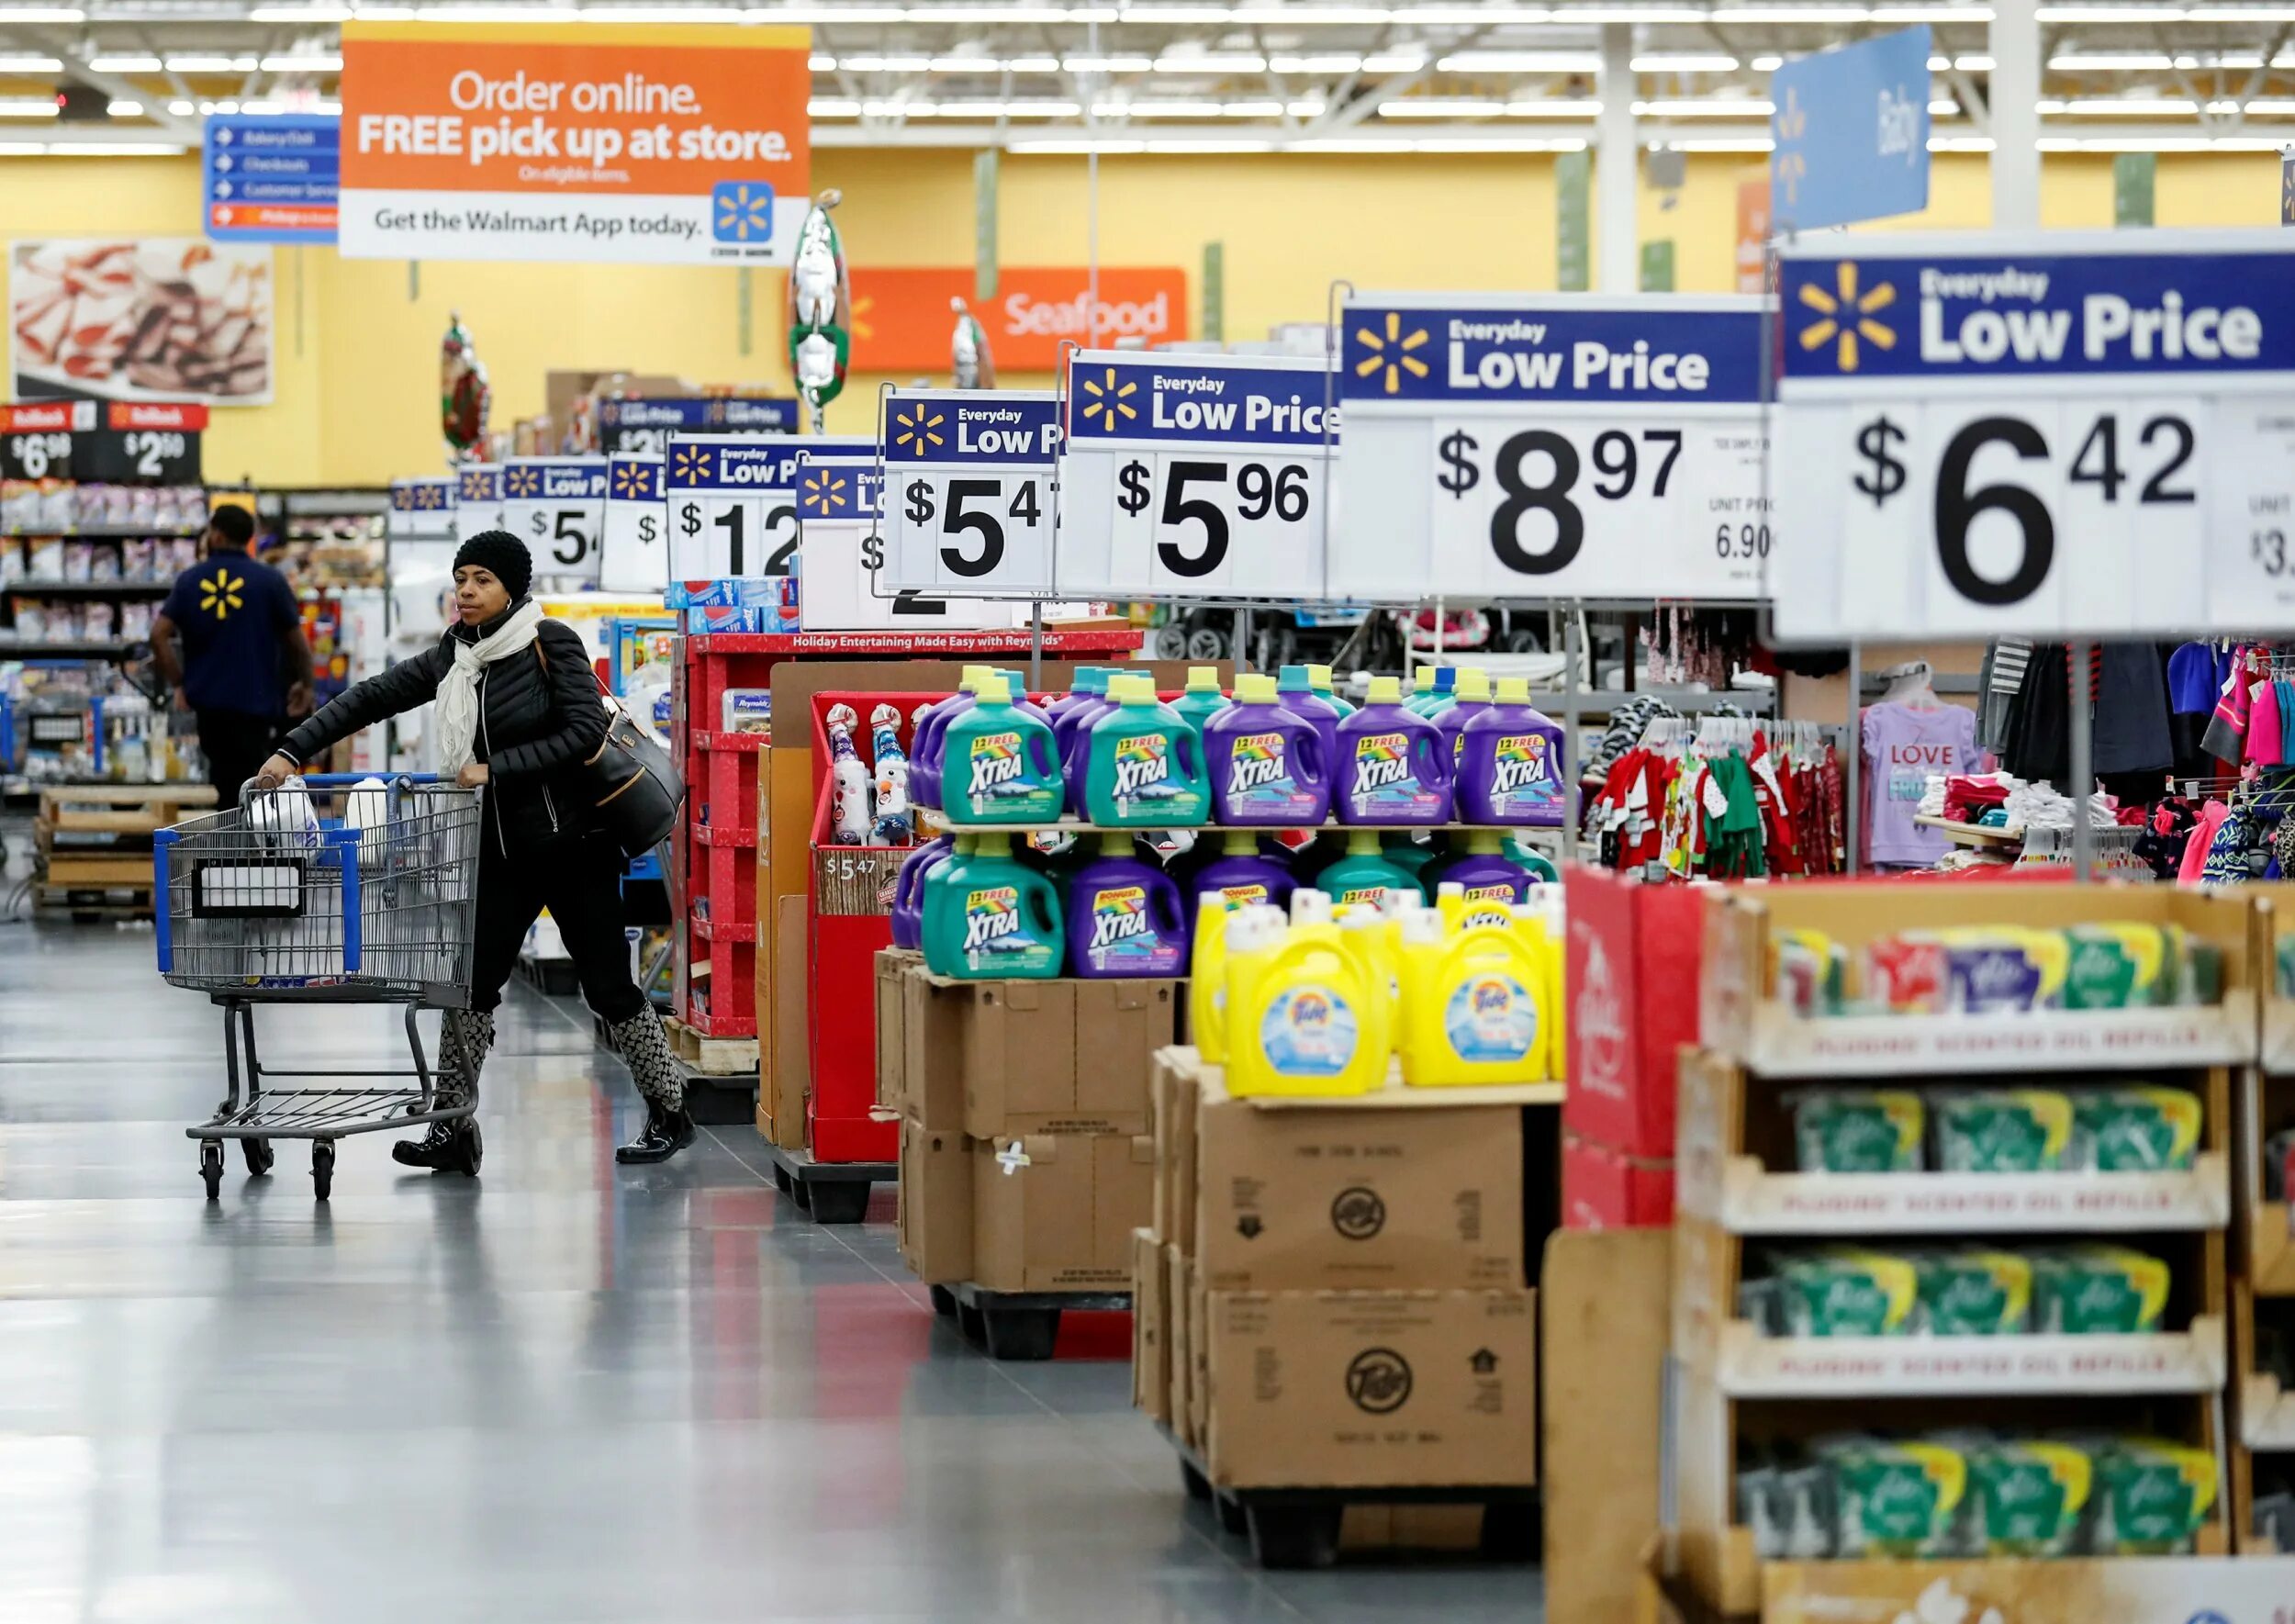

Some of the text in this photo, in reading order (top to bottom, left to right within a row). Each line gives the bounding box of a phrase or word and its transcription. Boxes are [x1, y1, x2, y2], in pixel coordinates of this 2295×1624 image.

[450, 70, 702, 114] Order online.
[358, 114, 792, 167] FREE pick up at store.
[375, 209, 702, 241] Get the Walmart App today.
[1920, 265, 2050, 304] Everyday
[1004, 291, 1168, 336] Seafood
[1449, 319, 1547, 344] Everyday
[1920, 289, 2263, 364] Low Price
[1449, 341, 1709, 390] Low Price
[1153, 375, 1225, 395] Everyday
[958, 409, 1023, 424] Everyday
[1153, 396, 1235, 431] Low
[957, 423, 1033, 454] Low
[721, 449, 767, 461] Everyday
[720, 460, 776, 483] Low
[544, 476, 588, 497] Low
[722, 581, 733, 605] Ziploc
[743, 608, 755, 632] Ziploc
[793, 635, 837, 649] Holiday
[840, 636, 912, 649] Entertaining
[914, 635, 946, 646] Made
[949, 635, 974, 647] Easy
[978, 634, 1002, 645] with
[738, 699, 769, 708] Reynolds
[988, 734, 1013, 745] FREE
[1133, 736, 1159, 746] FREE
[1249, 734, 1278, 745] FREE
[1373, 735, 1402, 745] FREE
[1513, 736, 1539, 746] FREE
[1892, 745, 1953, 764] LOVE
[968, 753, 1022, 794] XTRA
[1112, 756, 1167, 796] XTRA
[1227, 755, 1284, 794] XTRA
[1351, 756, 1408, 795] XTRA
[1490, 756, 1545, 795] XTRA
[983, 889, 1011, 900] FREE
[1358, 889, 1384, 900] FREE
[1481, 887, 1508, 898] FREE
[963, 908, 1019, 949] XTRA
[1089, 909, 1146, 949] XTRA
